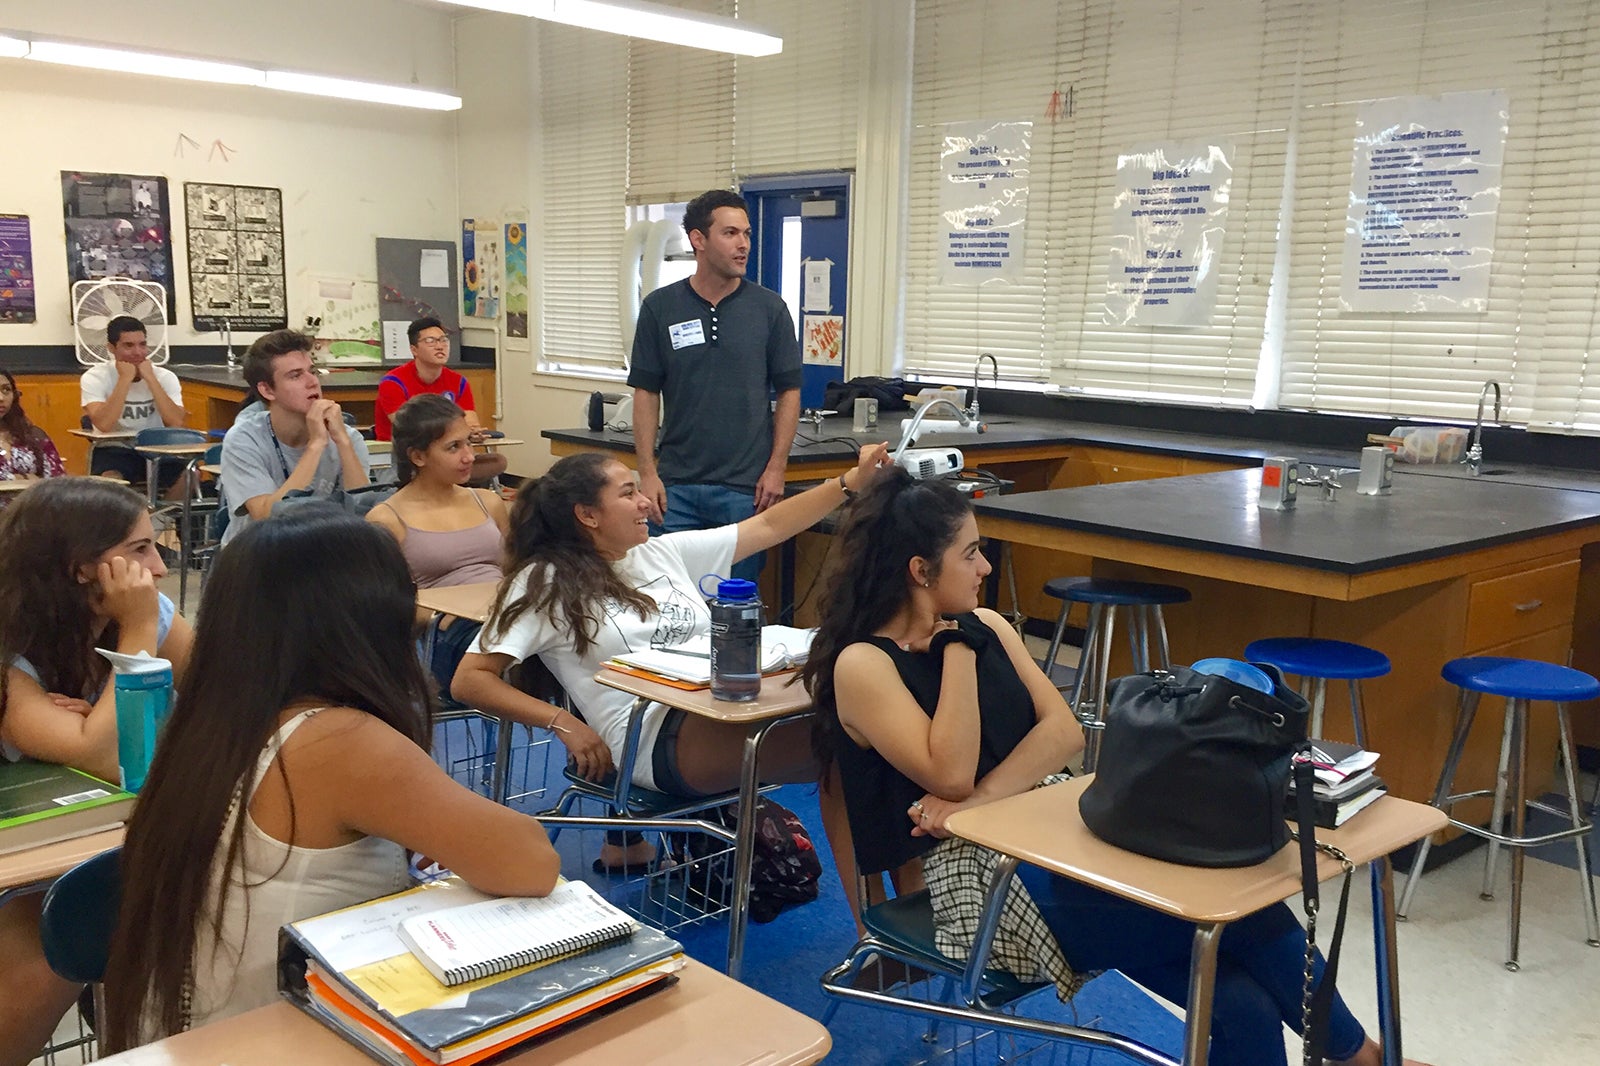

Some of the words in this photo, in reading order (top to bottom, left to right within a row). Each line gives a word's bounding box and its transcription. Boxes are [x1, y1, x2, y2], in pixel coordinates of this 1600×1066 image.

[1427, 129, 1464, 139] Practices:
[1153, 171, 1164, 180] Big
[122, 402, 156, 420] ANS
